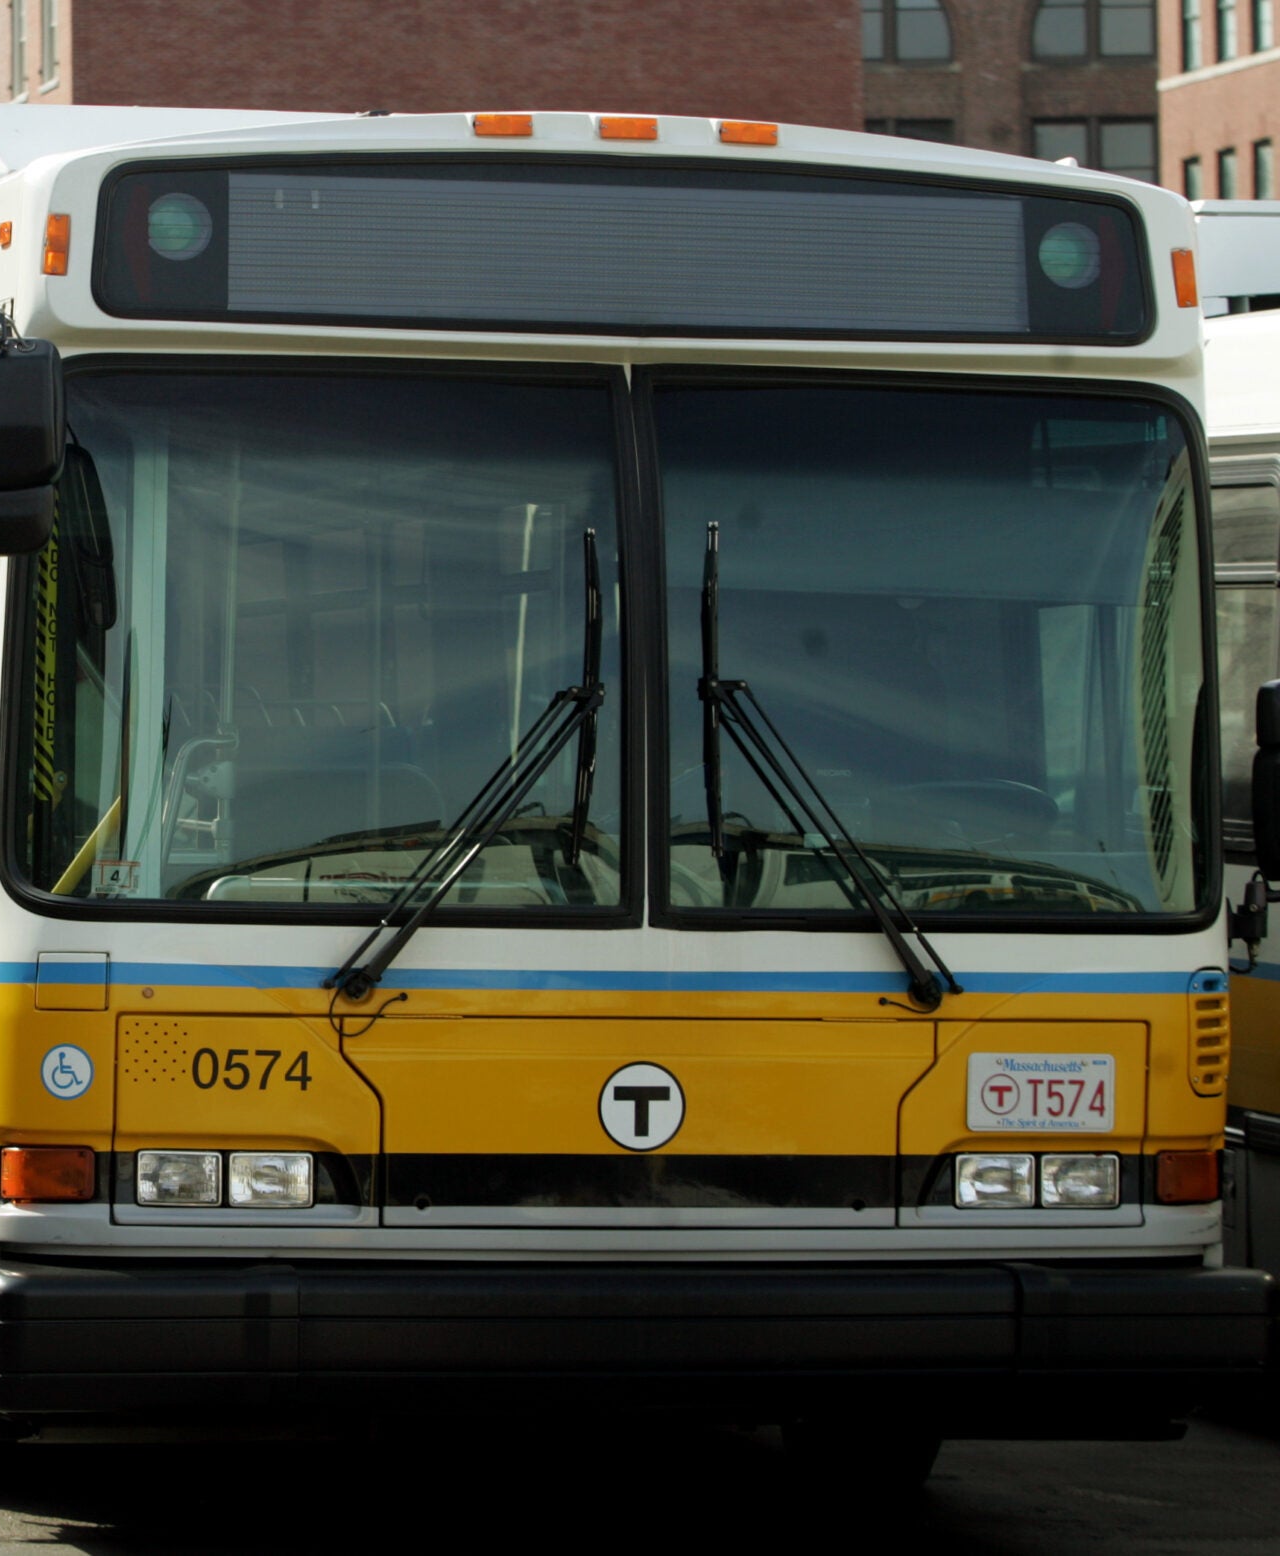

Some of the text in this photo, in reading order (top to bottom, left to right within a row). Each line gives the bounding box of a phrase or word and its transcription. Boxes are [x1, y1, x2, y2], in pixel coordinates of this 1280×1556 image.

[110, 869, 120, 883] 4
[191, 1047, 313, 1092] 0574
[1002, 1057, 1084, 1074] Massachusetts
[613, 1085, 671, 1138] T
[1026, 1078, 1106, 1118] T574
[1000, 1117, 1014, 1128] The
[1017, 1117, 1037, 1129] Spirit
[1048, 1119, 1080, 1129] America
